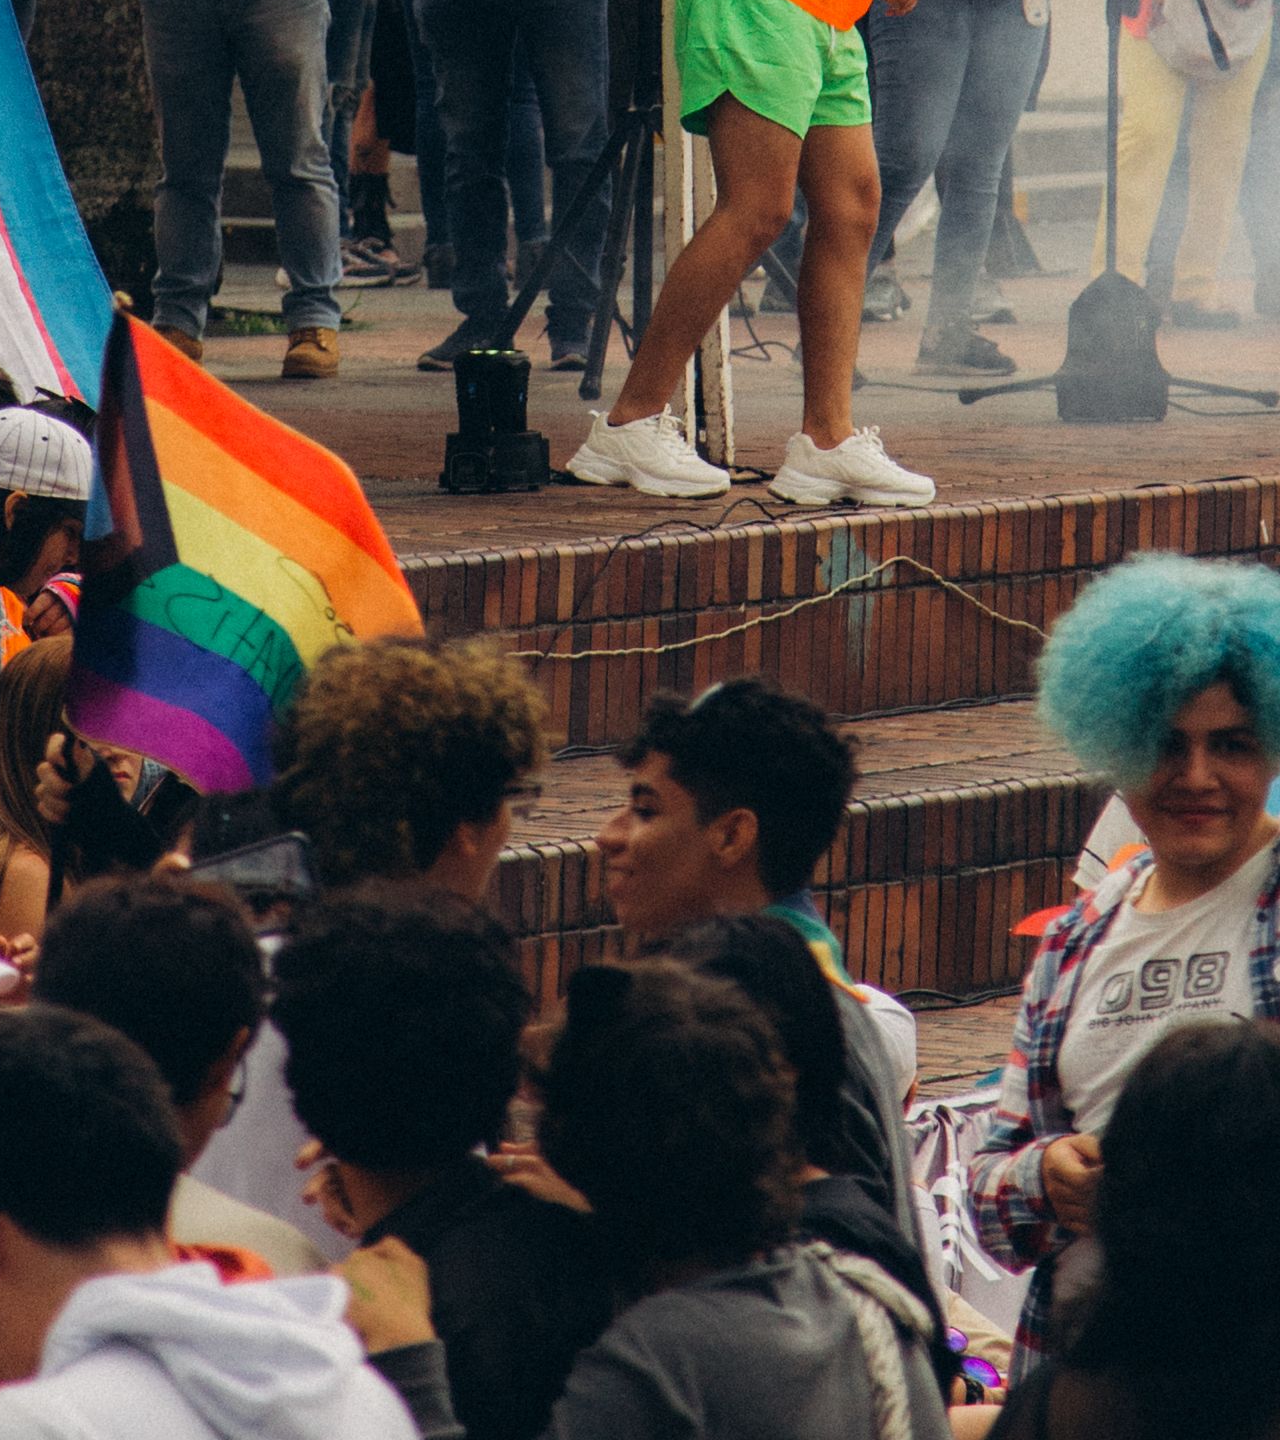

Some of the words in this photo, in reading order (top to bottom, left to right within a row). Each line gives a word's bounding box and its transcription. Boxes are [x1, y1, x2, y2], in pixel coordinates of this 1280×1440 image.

[1096, 950, 1231, 1015] 098
[1088, 1016, 1111, 1030] BIG
[1114, 1012, 1156, 1028] JOHN
